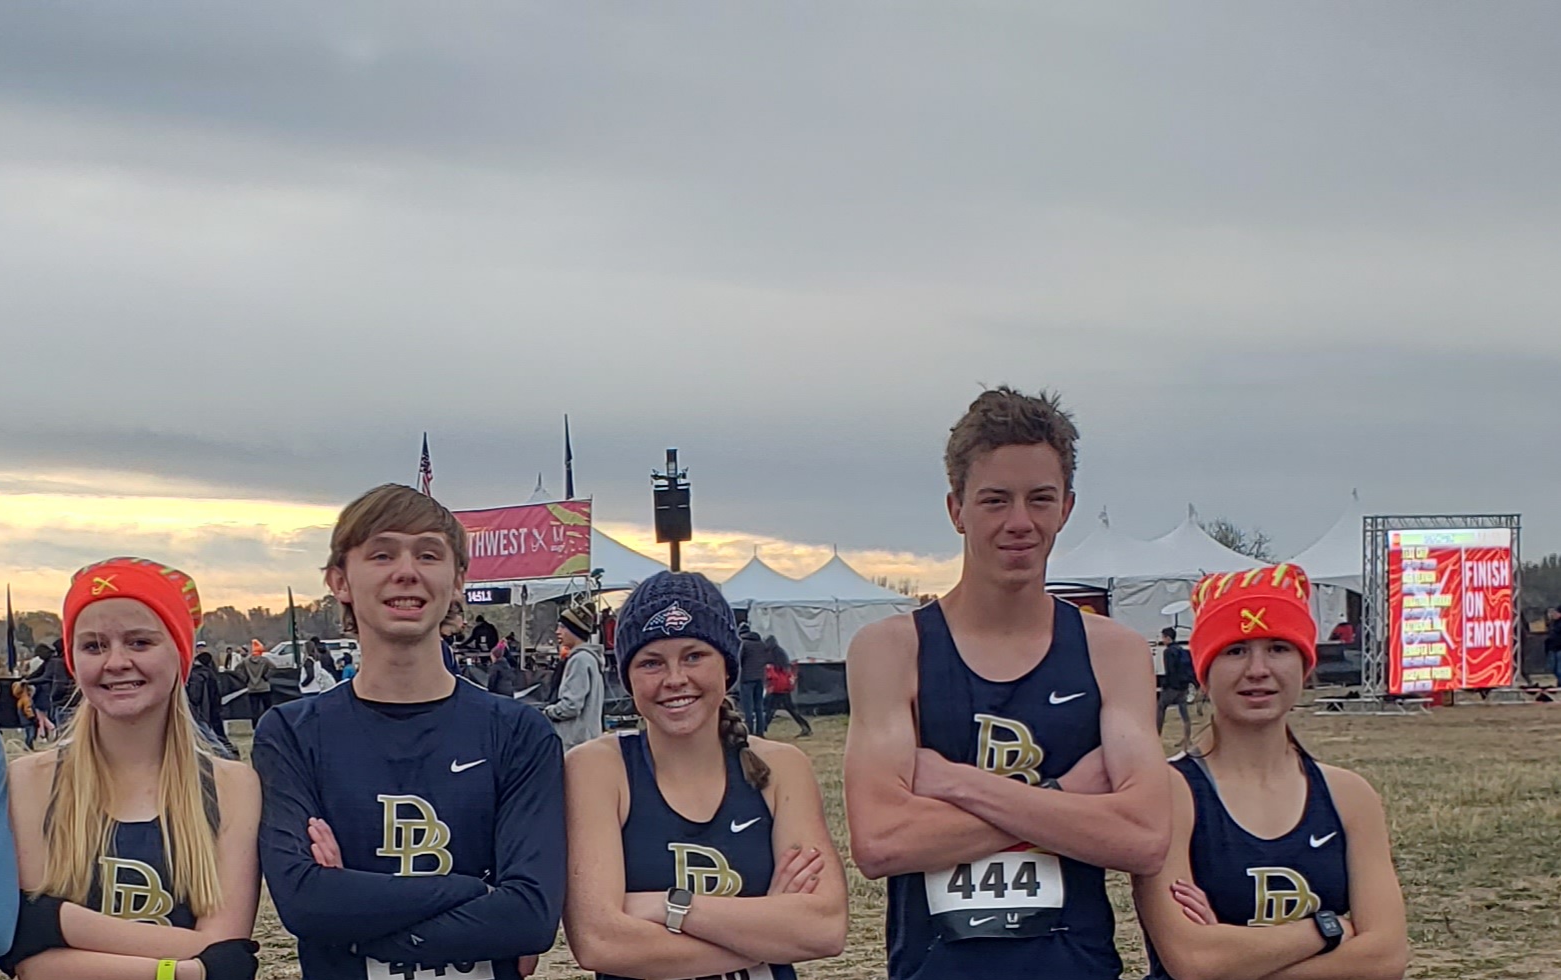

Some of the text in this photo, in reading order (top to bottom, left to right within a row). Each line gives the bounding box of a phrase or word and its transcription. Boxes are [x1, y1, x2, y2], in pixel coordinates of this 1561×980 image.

[1465, 560, 1509, 587] FINISH
[1465, 591, 1484, 618] ON
[1465, 620, 1511, 648] EMPTY
[376, 794, 454, 877] DB
[947, 861, 1041, 900] 444
